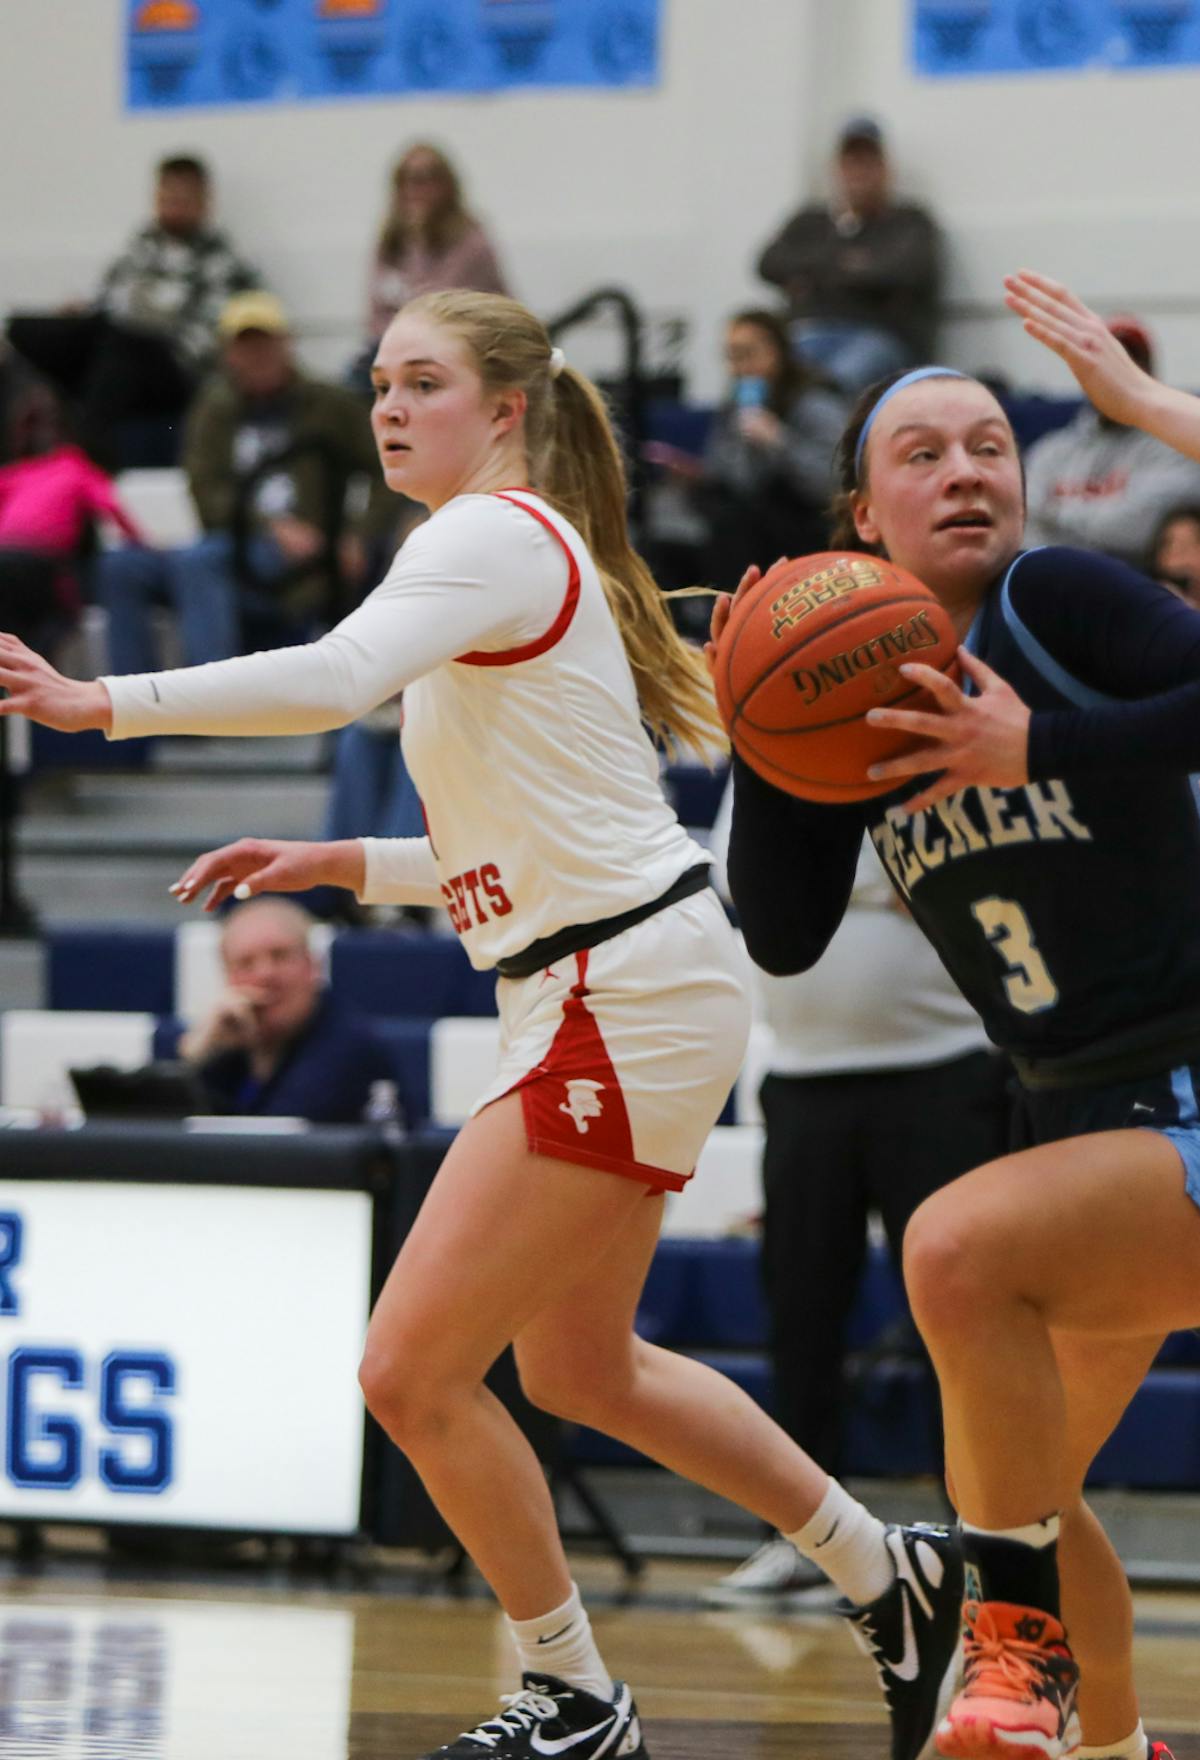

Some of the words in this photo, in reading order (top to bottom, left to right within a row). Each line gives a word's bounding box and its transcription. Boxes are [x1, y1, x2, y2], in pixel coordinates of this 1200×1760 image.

[771, 567, 900, 640] EGACY
[790, 609, 940, 706] SPALDING
[970, 895, 1060, 1015] 3
[7, 1346, 176, 1494] GS
